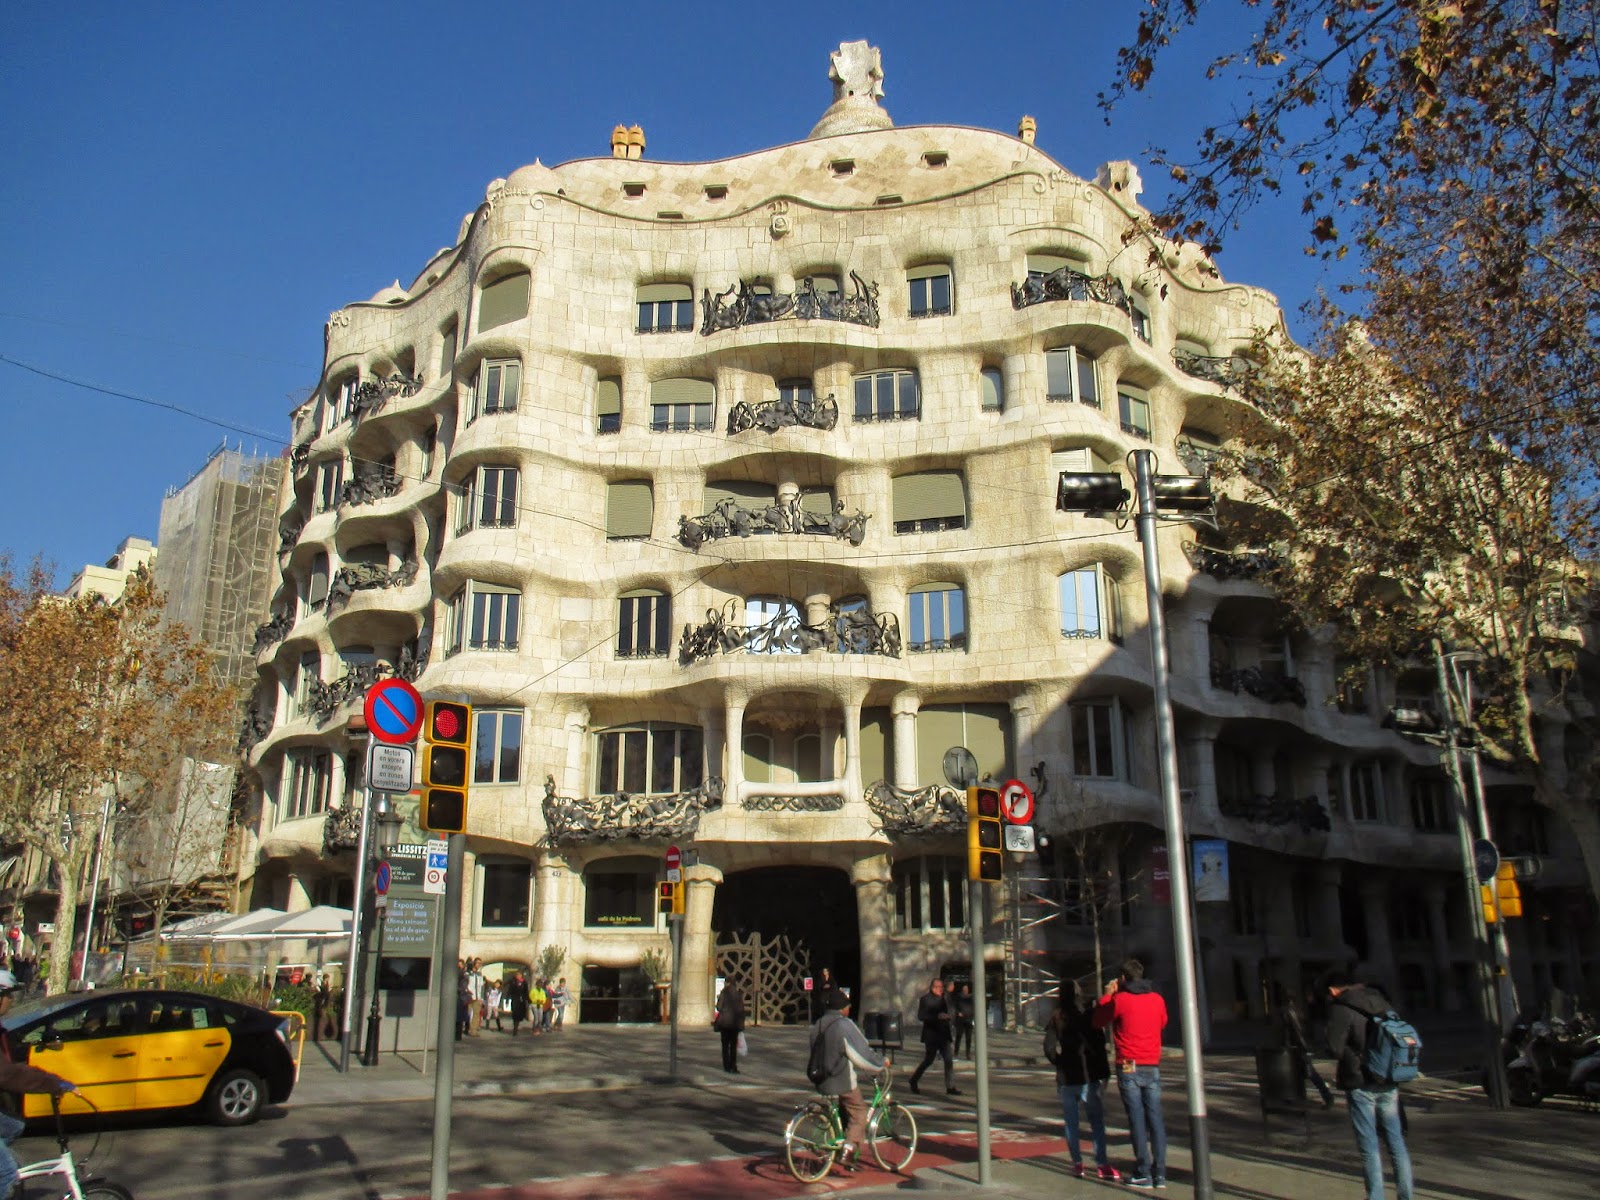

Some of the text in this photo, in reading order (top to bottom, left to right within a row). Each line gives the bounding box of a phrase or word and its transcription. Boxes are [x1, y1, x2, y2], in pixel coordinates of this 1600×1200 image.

[384, 749, 401, 757] Motos
[381, 764, 403, 772] excepte
[374, 779, 409, 788] senyalitzades
[393, 901, 424, 909] Exposició
